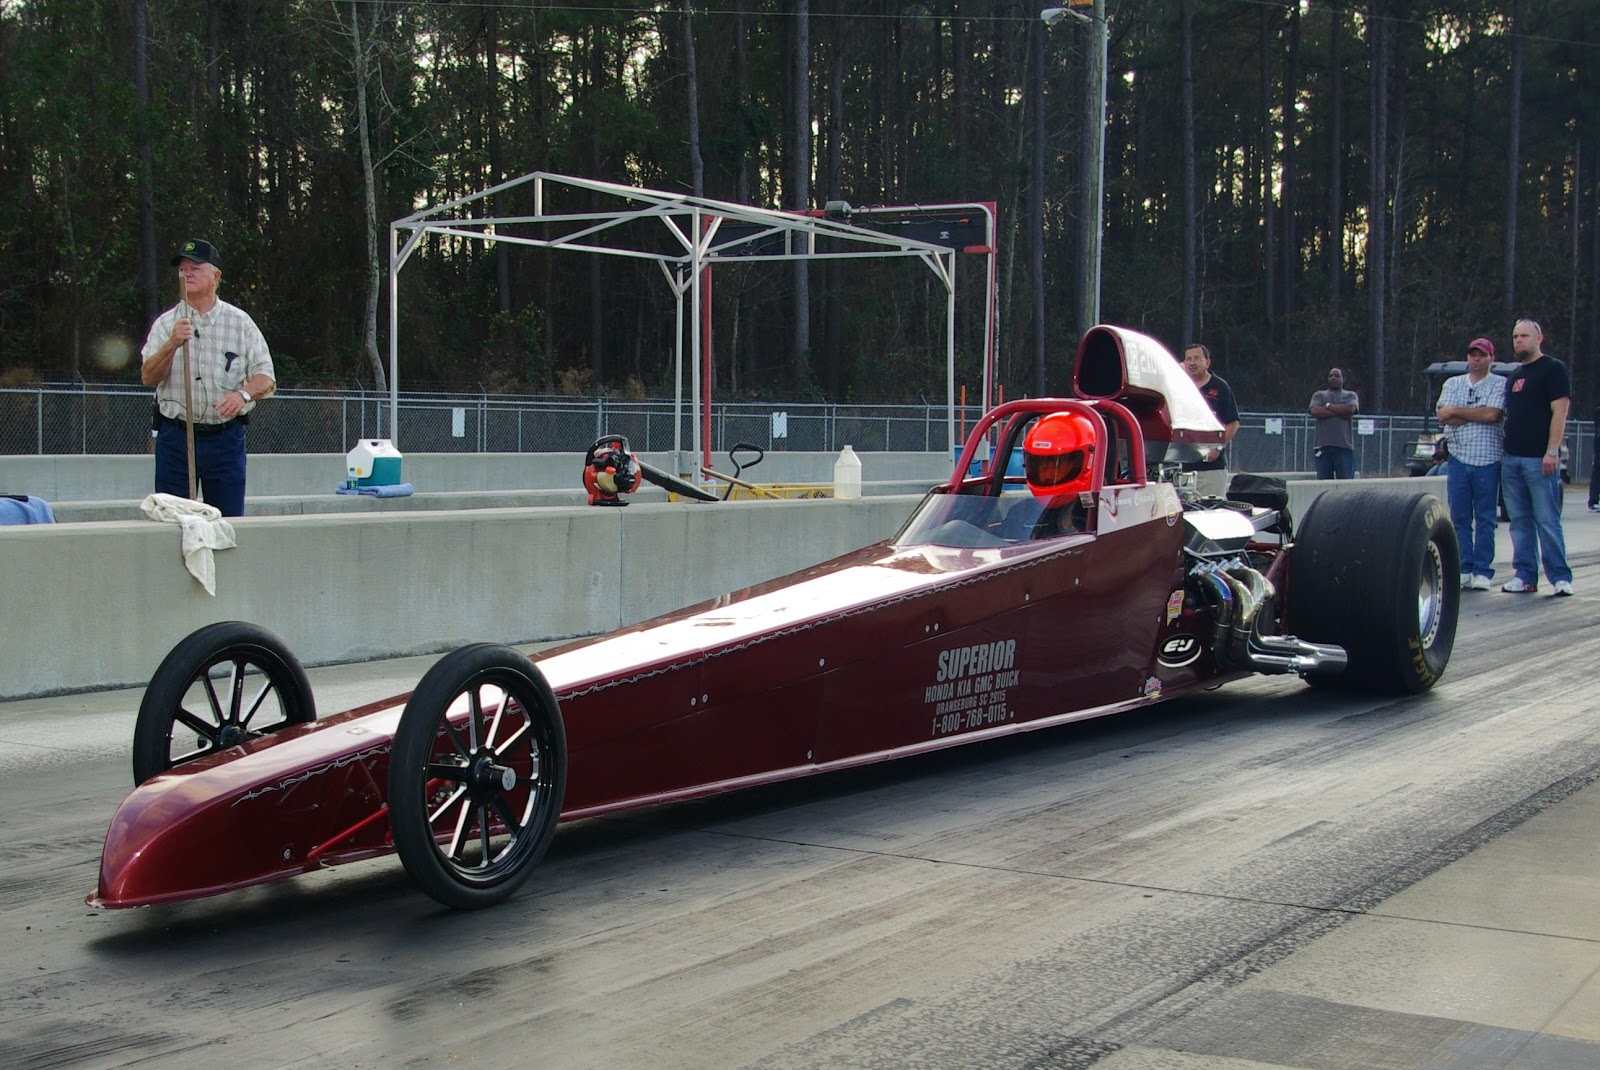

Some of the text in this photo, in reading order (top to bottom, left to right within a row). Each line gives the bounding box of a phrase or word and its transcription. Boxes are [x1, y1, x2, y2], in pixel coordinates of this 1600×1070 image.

[936, 639, 1016, 681] SUPERIOR
[924, 669, 1020, 703] HONDA KIA GMC BUICK
[979, 693, 988, 706] SC
[932, 703, 1007, 735] 1-800-768-0115
